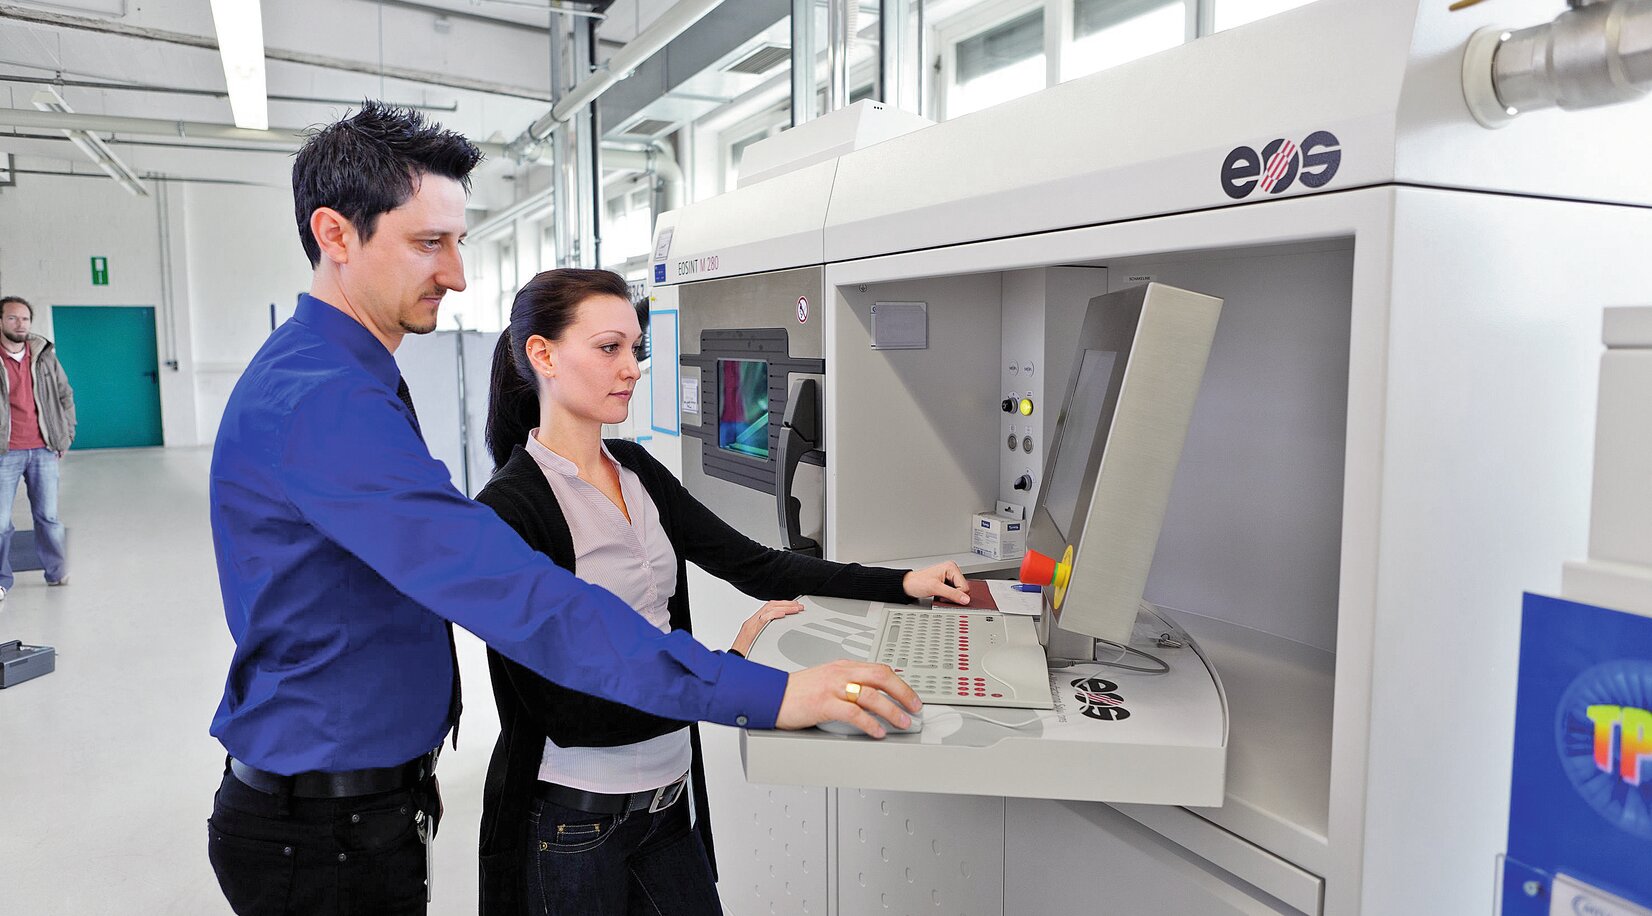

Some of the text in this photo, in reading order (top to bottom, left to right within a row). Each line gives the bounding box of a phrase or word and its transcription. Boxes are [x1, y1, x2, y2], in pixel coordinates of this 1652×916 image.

[1220, 130, 1342, 200] eos
[678, 259, 698, 276] EOSINT
[700, 258, 706, 272] M
[707, 255, 720, 272] 280
